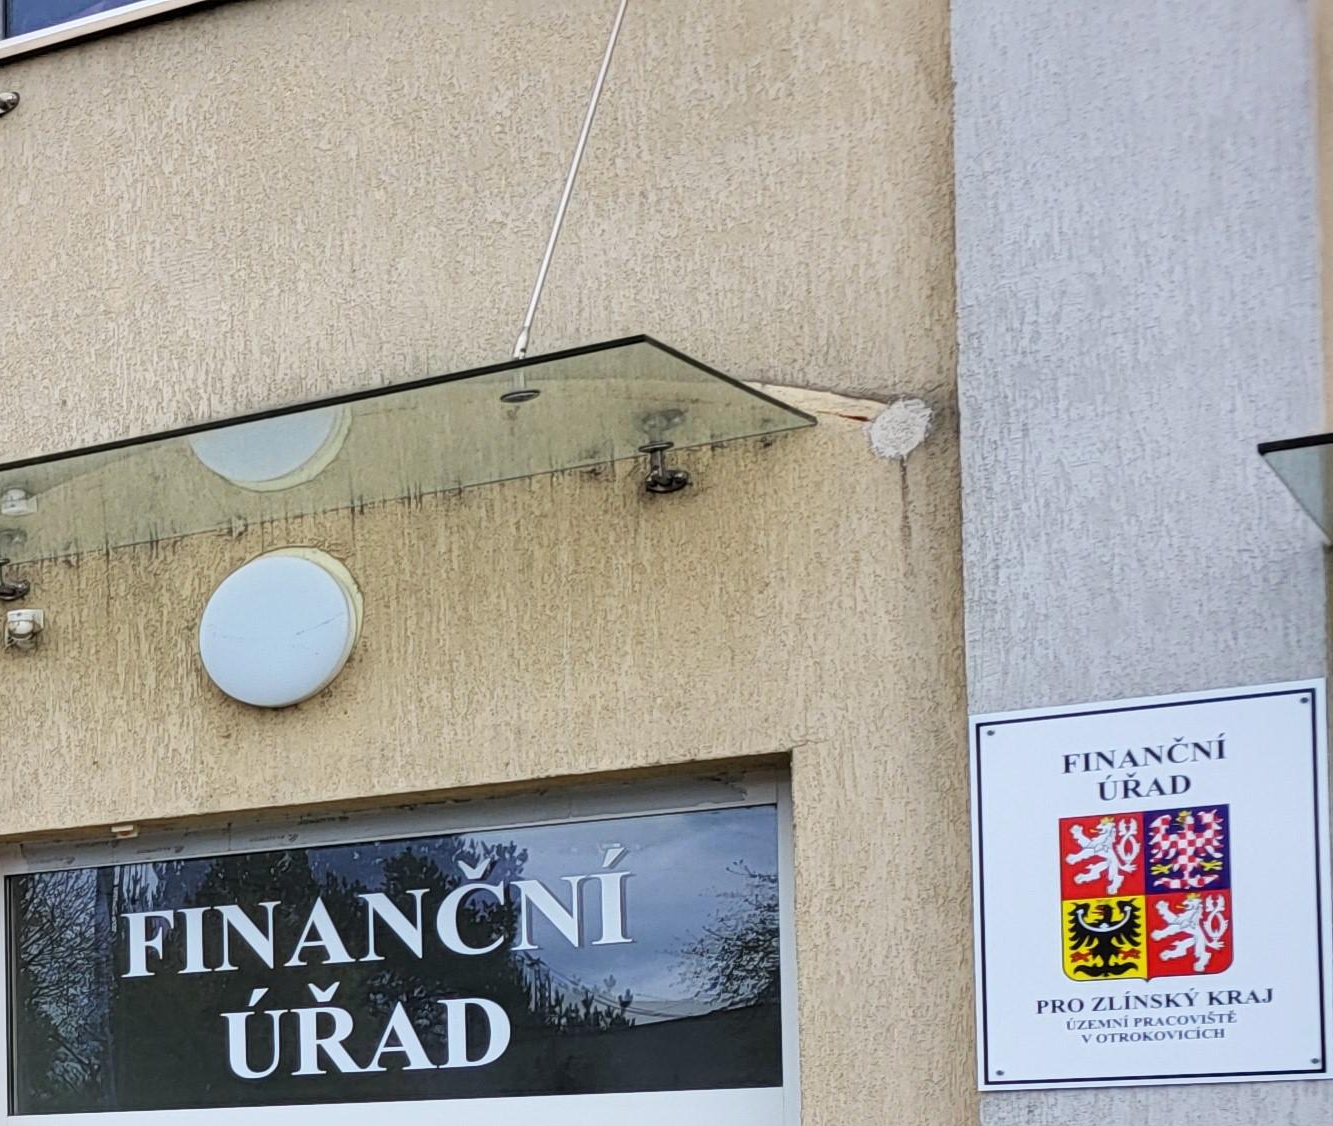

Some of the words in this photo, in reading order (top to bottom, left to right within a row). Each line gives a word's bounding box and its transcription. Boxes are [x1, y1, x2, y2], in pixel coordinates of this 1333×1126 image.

[1061, 733, 1228, 775] FINANČNÍ
[1097, 774, 1192, 801] ÚŘAD
[120, 843, 634, 979] FINANČNÍ
[1037, 998, 1085, 1015] PRO
[1091, 989, 1200, 1013] ZLÍNSKÝ
[1207, 988, 1274, 1006] KRAJ
[219, 981, 513, 1080] ÚŘAD
[1066, 1015, 1129, 1031] ÚZEMNÍ
[1133, 1010, 1238, 1027] PRACOVIŠTĚ
[1081, 1033, 1093, 1044] V
[1095, 1027, 1226, 1043] OTROKOVICÍCH
